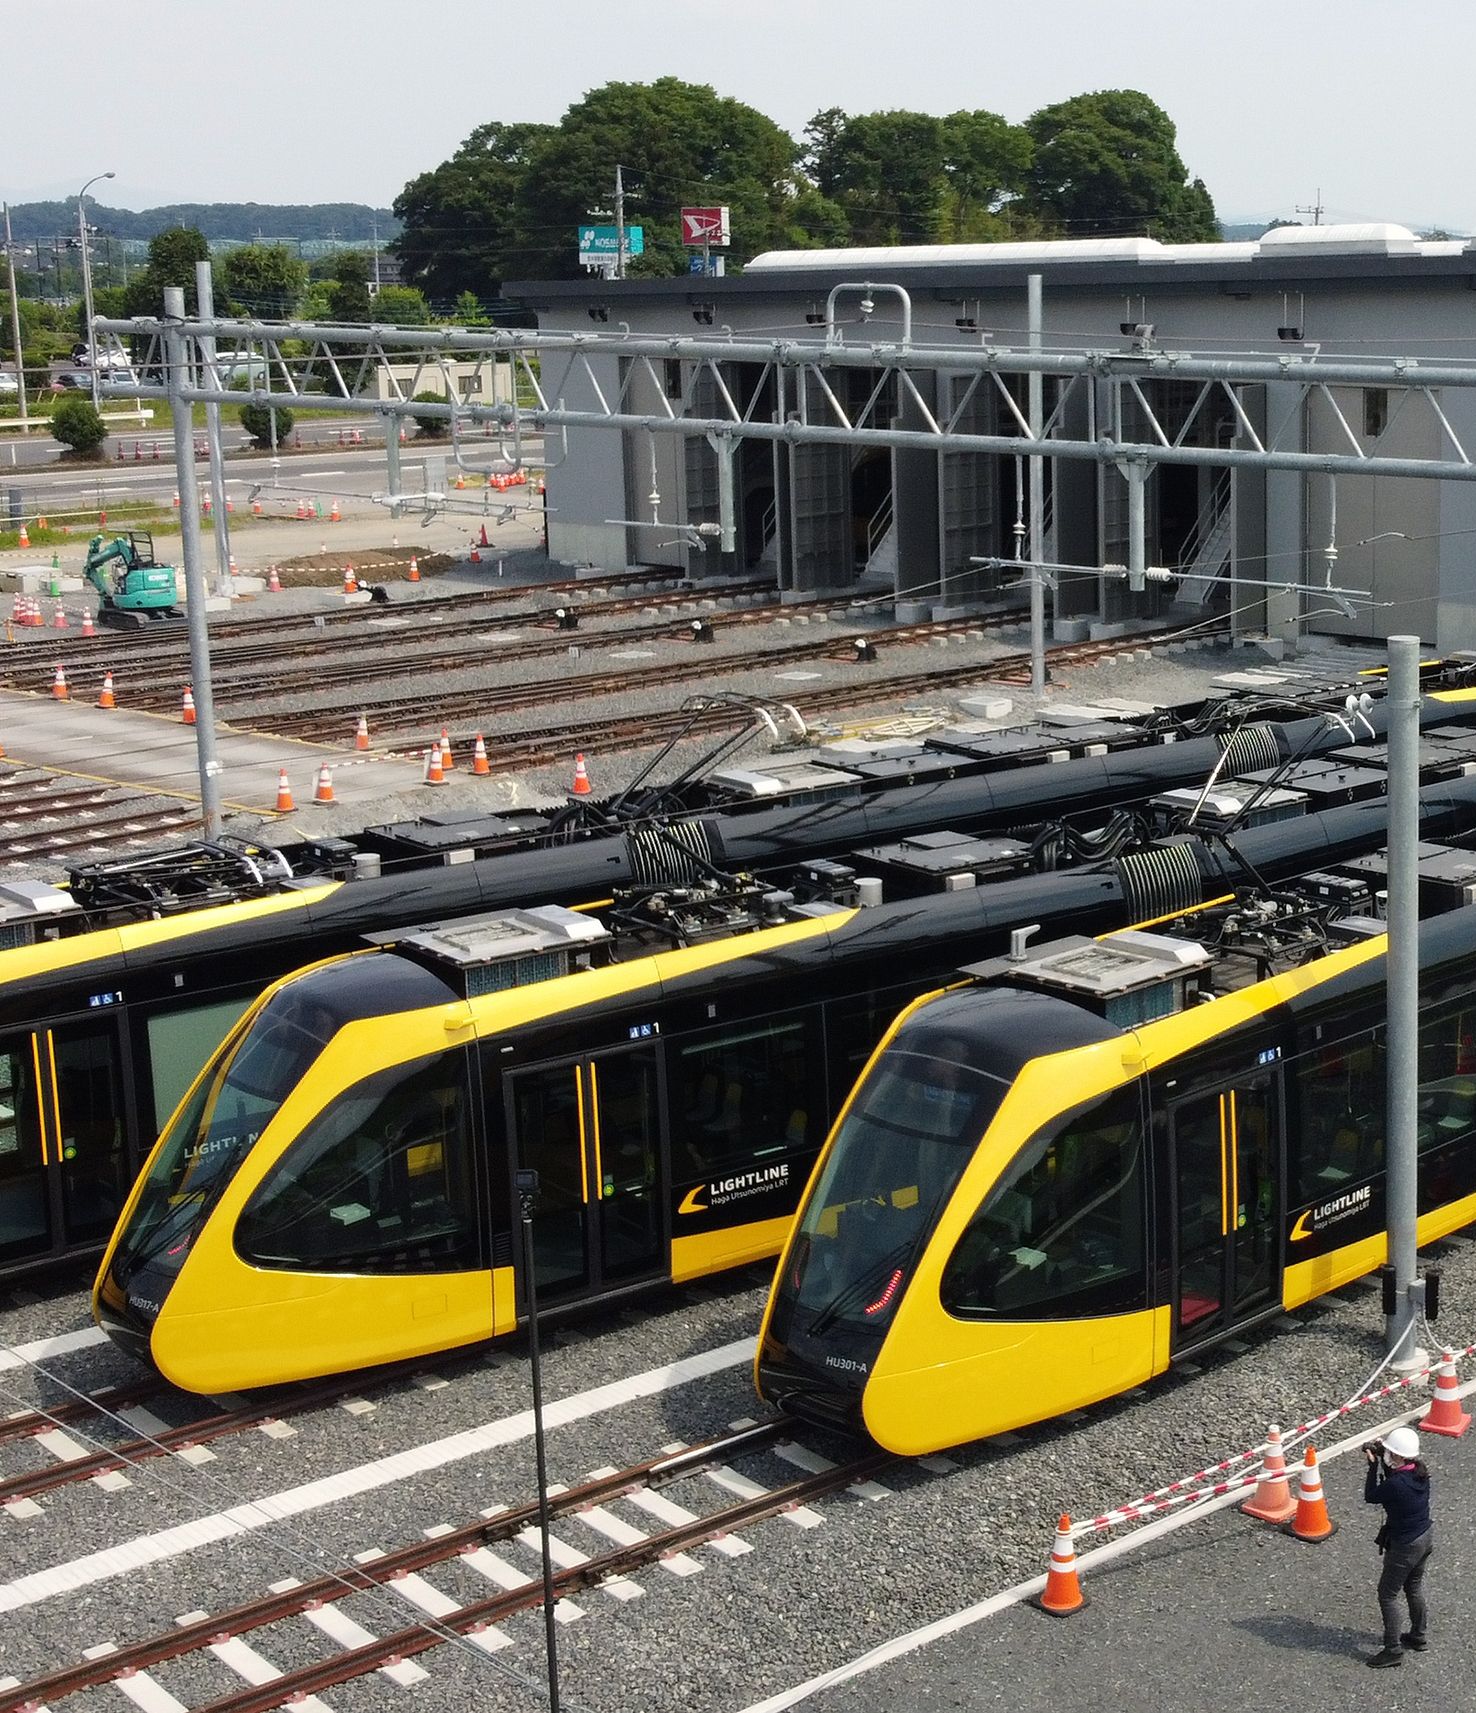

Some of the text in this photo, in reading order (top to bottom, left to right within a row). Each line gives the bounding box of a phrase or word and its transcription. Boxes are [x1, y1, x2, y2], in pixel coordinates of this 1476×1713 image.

[1304, 343, 1321, 367] 7
[115, 991, 122, 1002] 1
[653, 1021, 660, 1034] 1
[1276, 1046, 1281, 1058] 1
[710, 1164, 789, 1196] LIGHTLINE
[711, 1177, 789, 1206] Haga Utsunomiya LRT
[1313, 1185, 1371, 1221] LIGHTLINE
[825, 1356, 868, 1373] HU301-A
